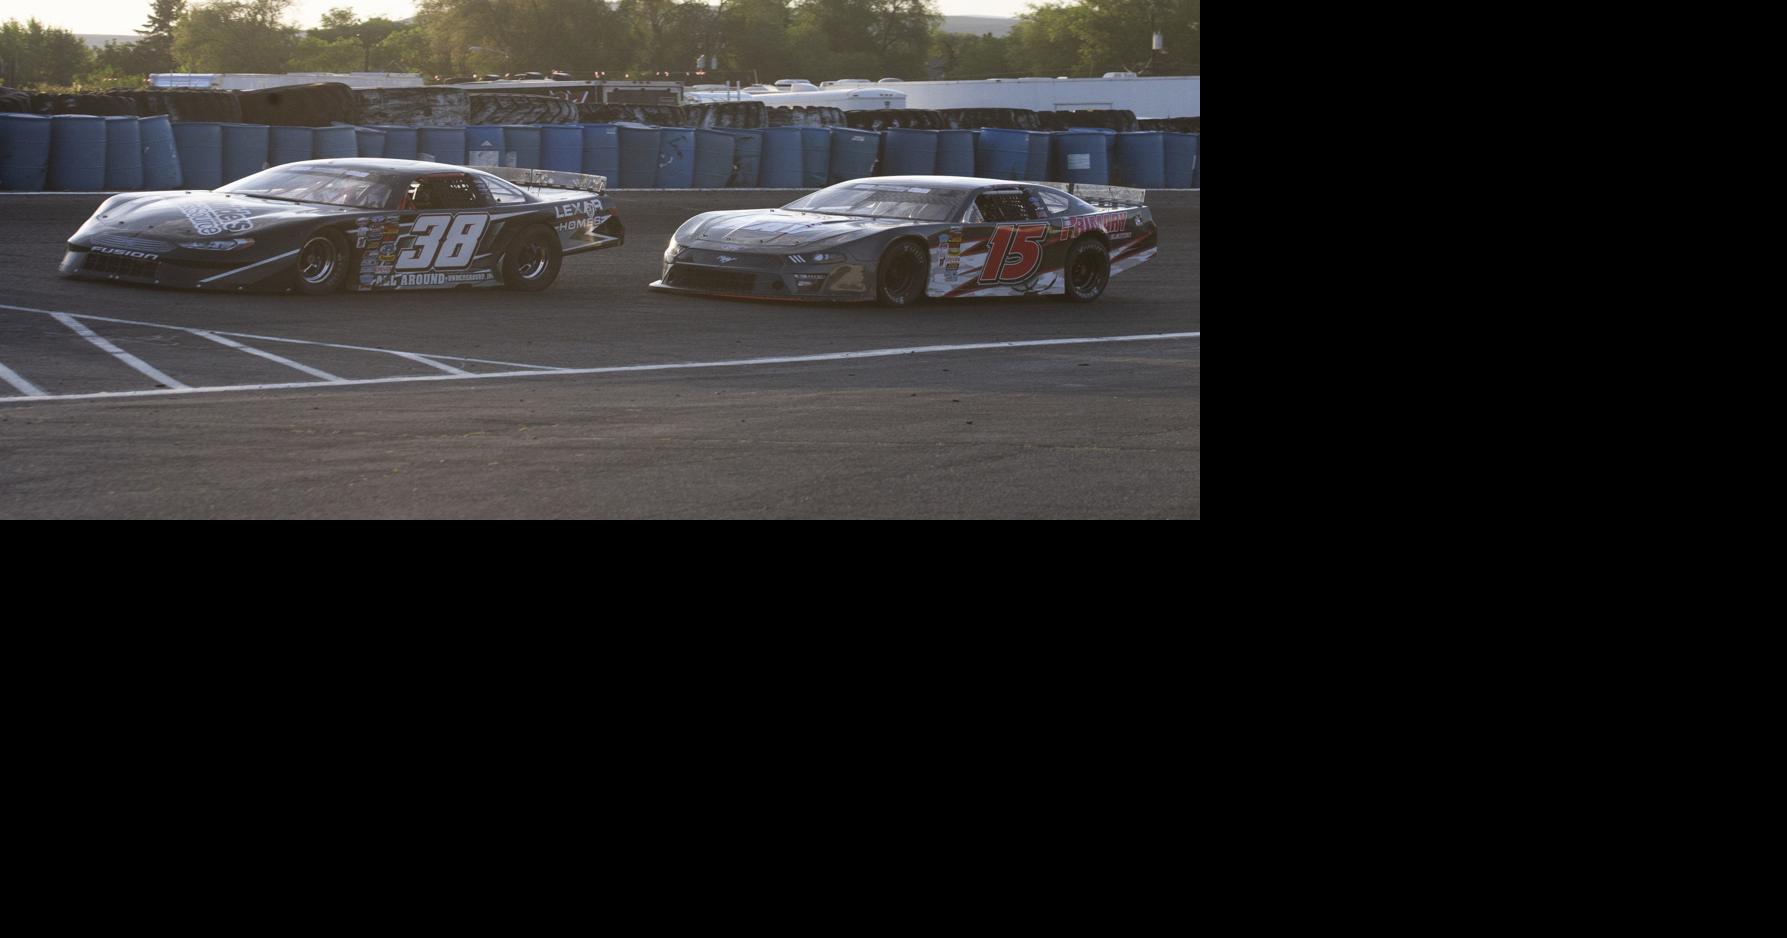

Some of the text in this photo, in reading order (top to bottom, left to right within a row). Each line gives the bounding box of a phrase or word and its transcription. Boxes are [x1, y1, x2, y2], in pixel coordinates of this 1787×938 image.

[559, 216, 601, 232] HOMES
[394, 212, 491, 272] 38
[90, 245, 160, 261] FUSION
[978, 222, 1050, 286] 15
[376, 274, 397, 286] ALL
[401, 272, 445, 286] AROUND
